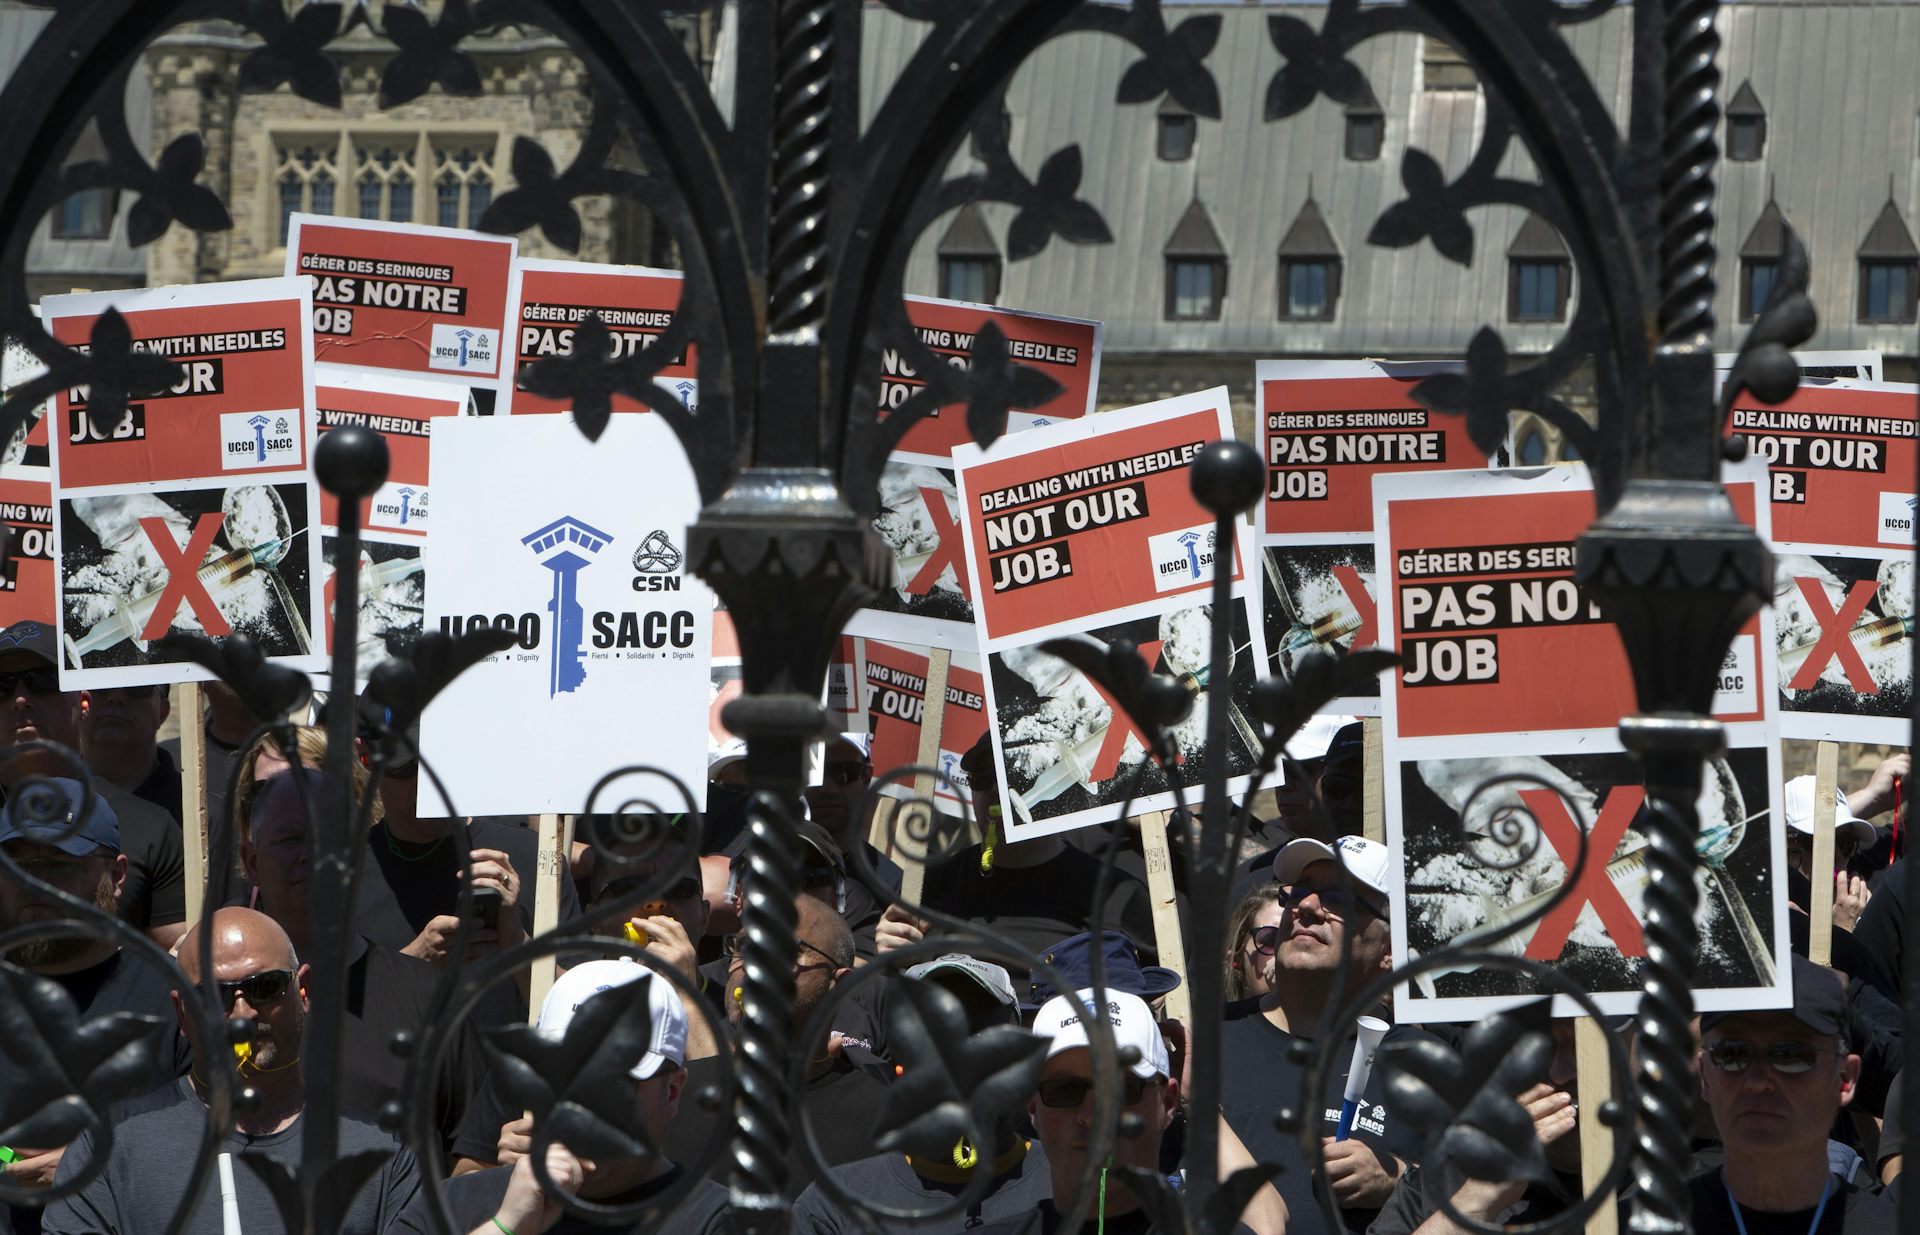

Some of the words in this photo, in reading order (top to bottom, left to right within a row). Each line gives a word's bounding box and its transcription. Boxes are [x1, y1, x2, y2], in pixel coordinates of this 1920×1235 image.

[301, 254, 345, 271] GÉRER
[348, 260, 374, 274] DES
[376, 263, 451, 281] SERINGUES
[362, 281, 461, 313] NOTRE
[313, 307, 352, 334] OB
[523, 303, 565, 321] GÉRER
[148, 336, 195, 355] WITH
[200, 330, 285, 352] NEEDLES
[436, 347, 459, 357] UCCO
[468, 350, 490, 360] SACC
[520, 327, 576, 357] PAS
[325, 410, 366, 427] WITH
[369, 416, 430, 436] NEEDLE
[1268, 412, 1314, 429] GÉRER
[1317, 414, 1343, 428] DES
[1346, 412, 1426, 427] SERINGUES
[1733, 410, 1812, 430] DEALING
[1815, 414, 1862, 433] WITH
[228, 441, 255, 452] UCCO
[266, 438, 293, 450] SACC
[1269, 436, 1327, 464] PAS
[1336, 433, 1438, 463] NOTRE
[1808, 438, 1879, 470] OUR
[980, 477, 1062, 512] DEALING
[1064, 466, 1115, 491] WITH
[1269, 471, 1328, 499] JOB
[376, 504, 400, 515] UCCO
[986, 505, 1056, 550] NOT
[1065, 487, 1141, 531] OUR
[1885, 518, 1911, 529] UCCO
[993, 547, 1072, 590] JOB.
[1160, 558, 1188, 574] UCCO
[1398, 549, 1474, 575] GÉRER
[1479, 550, 1521, 570] DES
[632, 576, 681, 592] CSN
[1402, 584, 1496, 629] PAS
[592, 610, 695, 650] SACC
[517, 653, 540, 662] Dignity
[591, 652, 609, 660] Fierté
[626, 651, 655, 660] Solidarité
[672, 651, 695, 661] Dignité
[1402, 638, 1498, 684] JOB
[891, 669, 925, 691] WITH
[1360, 1116, 1385, 1133] SACC
